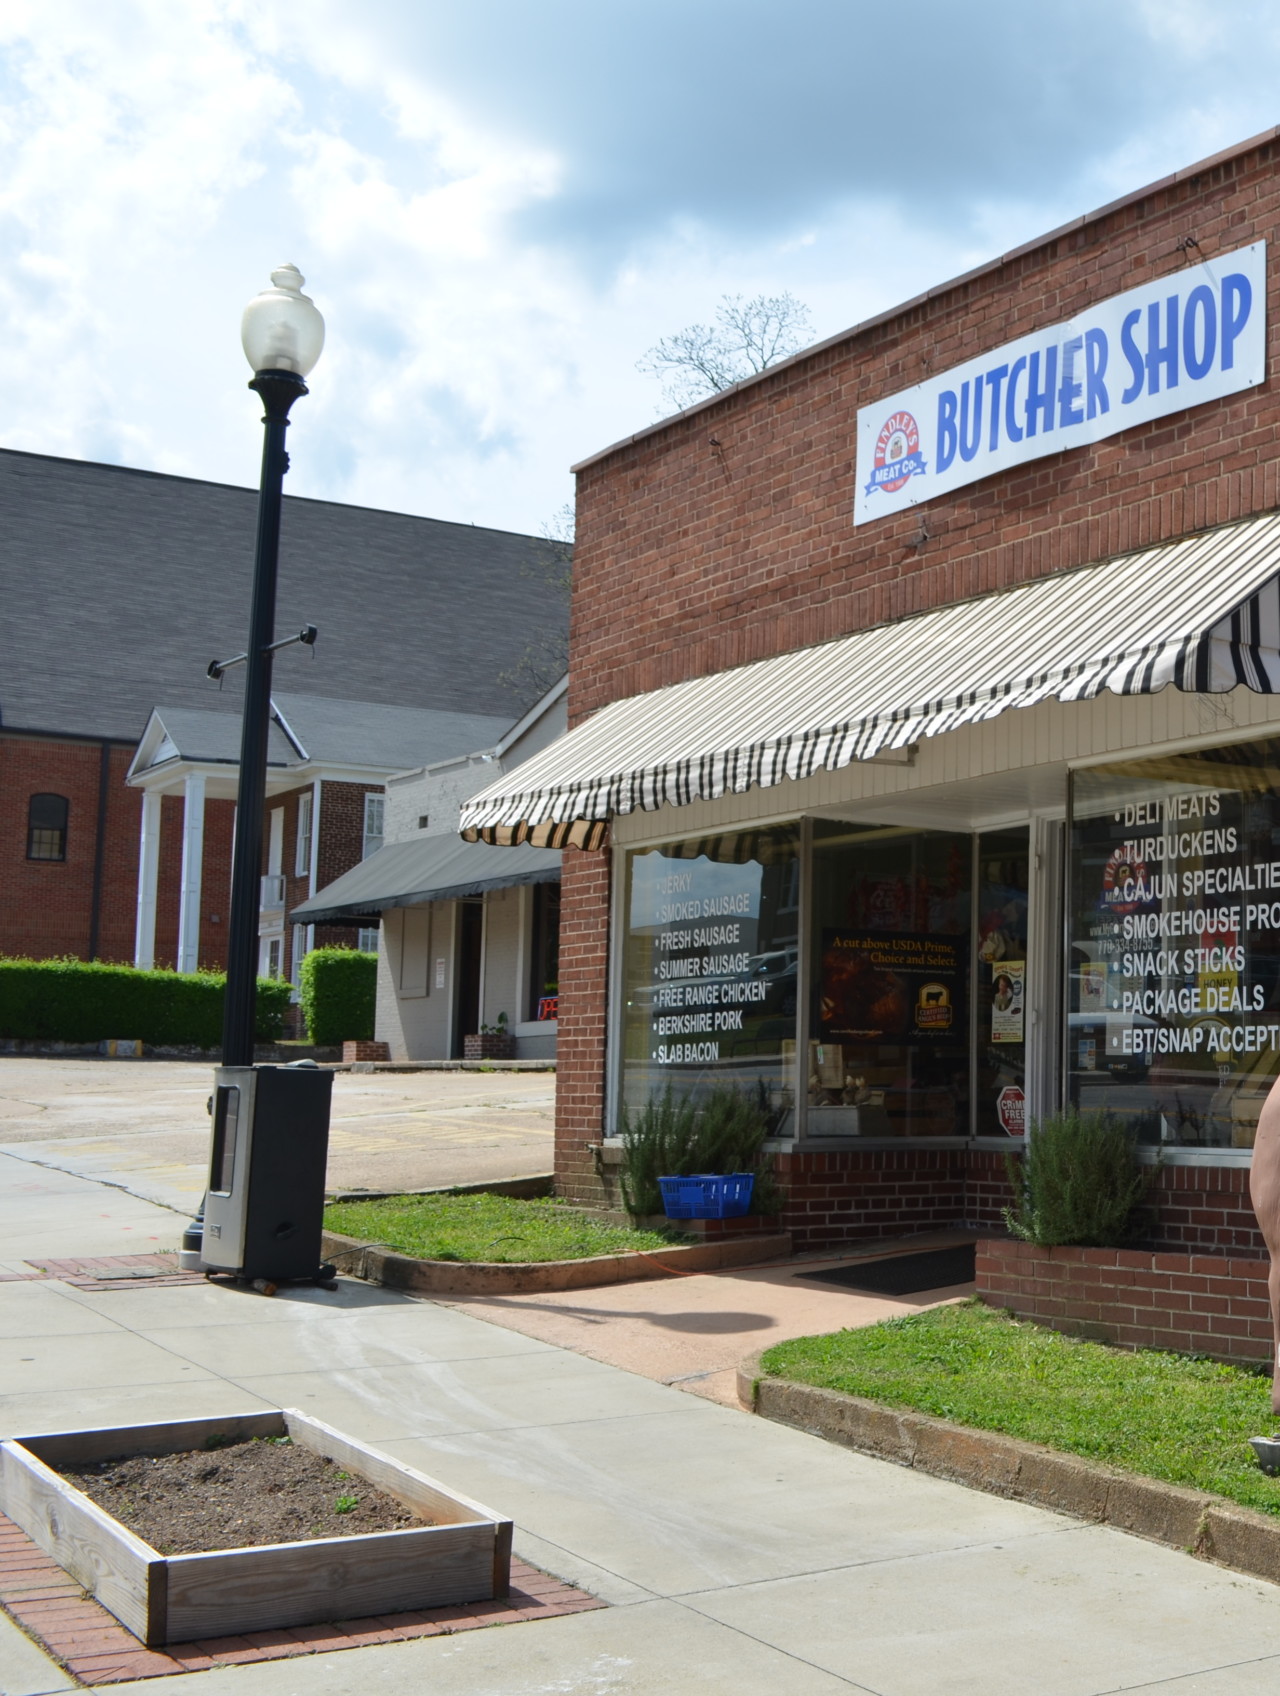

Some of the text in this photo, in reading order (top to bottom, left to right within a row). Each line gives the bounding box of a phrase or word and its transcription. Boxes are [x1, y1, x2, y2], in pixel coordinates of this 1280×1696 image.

[936, 273, 1252, 475] BUTCHER SHOP
[875, 414, 918, 459] FINDLEY'S
[874, 464, 901, 484] MEAT
[1124, 791, 1220, 828] DELI MEATS
[1124, 827, 1237, 865] TURDUCKENS
[662, 873, 692, 894] JERKY
[1123, 872, 1178, 902] CAJUN
[662, 893, 750, 922] SMOKED SAUSAGE
[1123, 905, 1241, 941] SMOKEHOUSE
[660, 924, 740, 951] FRESH SAUSAGE
[833, 936, 842, 948] A
[842, 939, 860, 949] cut
[861, 937, 891, 950] above
[892, 940, 922, 951] USDA
[660, 953, 750, 980] SUMMER SAUSAGE
[870, 952, 904, 964] Choice
[906, 954, 925, 966] and
[1122, 945, 1246, 978] SNACK STICKS
[659, 980, 766, 1008] FREE RANGE CHICKEN
[1203, 978, 1233, 989] HONEY
[1122, 984, 1265, 1016] PACKAGE DEALS
[658, 1009, 743, 1036] BERKSHIRE PORK
[658, 1041, 719, 1064] SLAB BACON
[1122, 1027, 1204, 1055] EBT/SNAP
